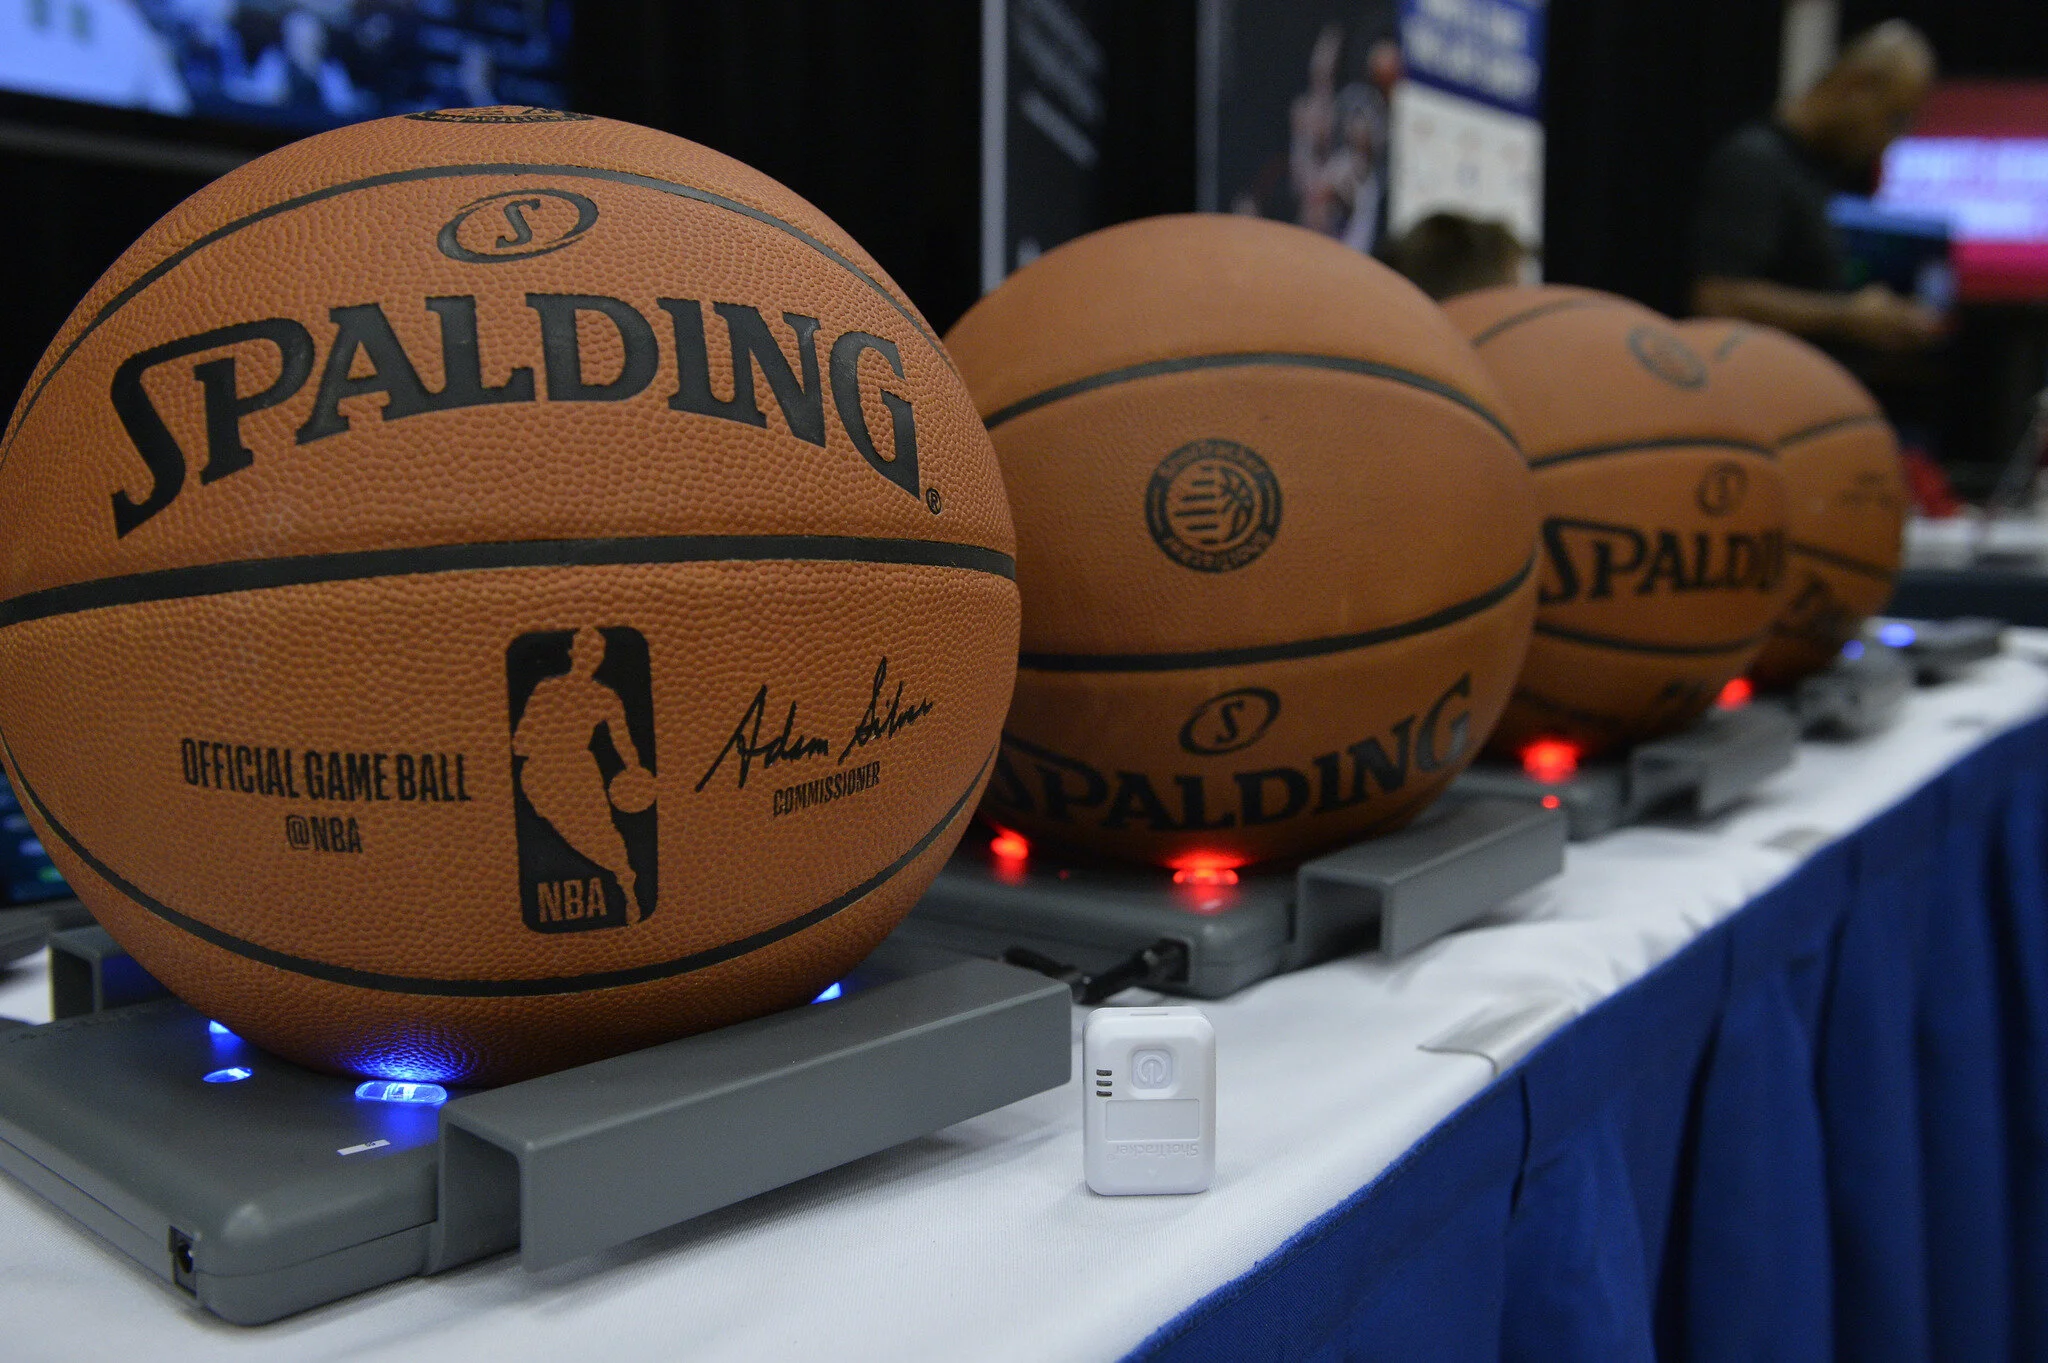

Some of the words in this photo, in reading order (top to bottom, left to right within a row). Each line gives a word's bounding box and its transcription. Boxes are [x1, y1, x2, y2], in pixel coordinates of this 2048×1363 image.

[110, 292, 921, 540] SPALDING
[694, 684, 829, 793] Adam
[181, 737, 301, 799] OFFICIAL
[303, 750, 391, 801] GAME
[395, 753, 472, 802] BALL
[772, 760, 881, 817] COMMISSIONER
[285, 813, 363, 853] @NBA
[536, 876, 608, 923] NBA
